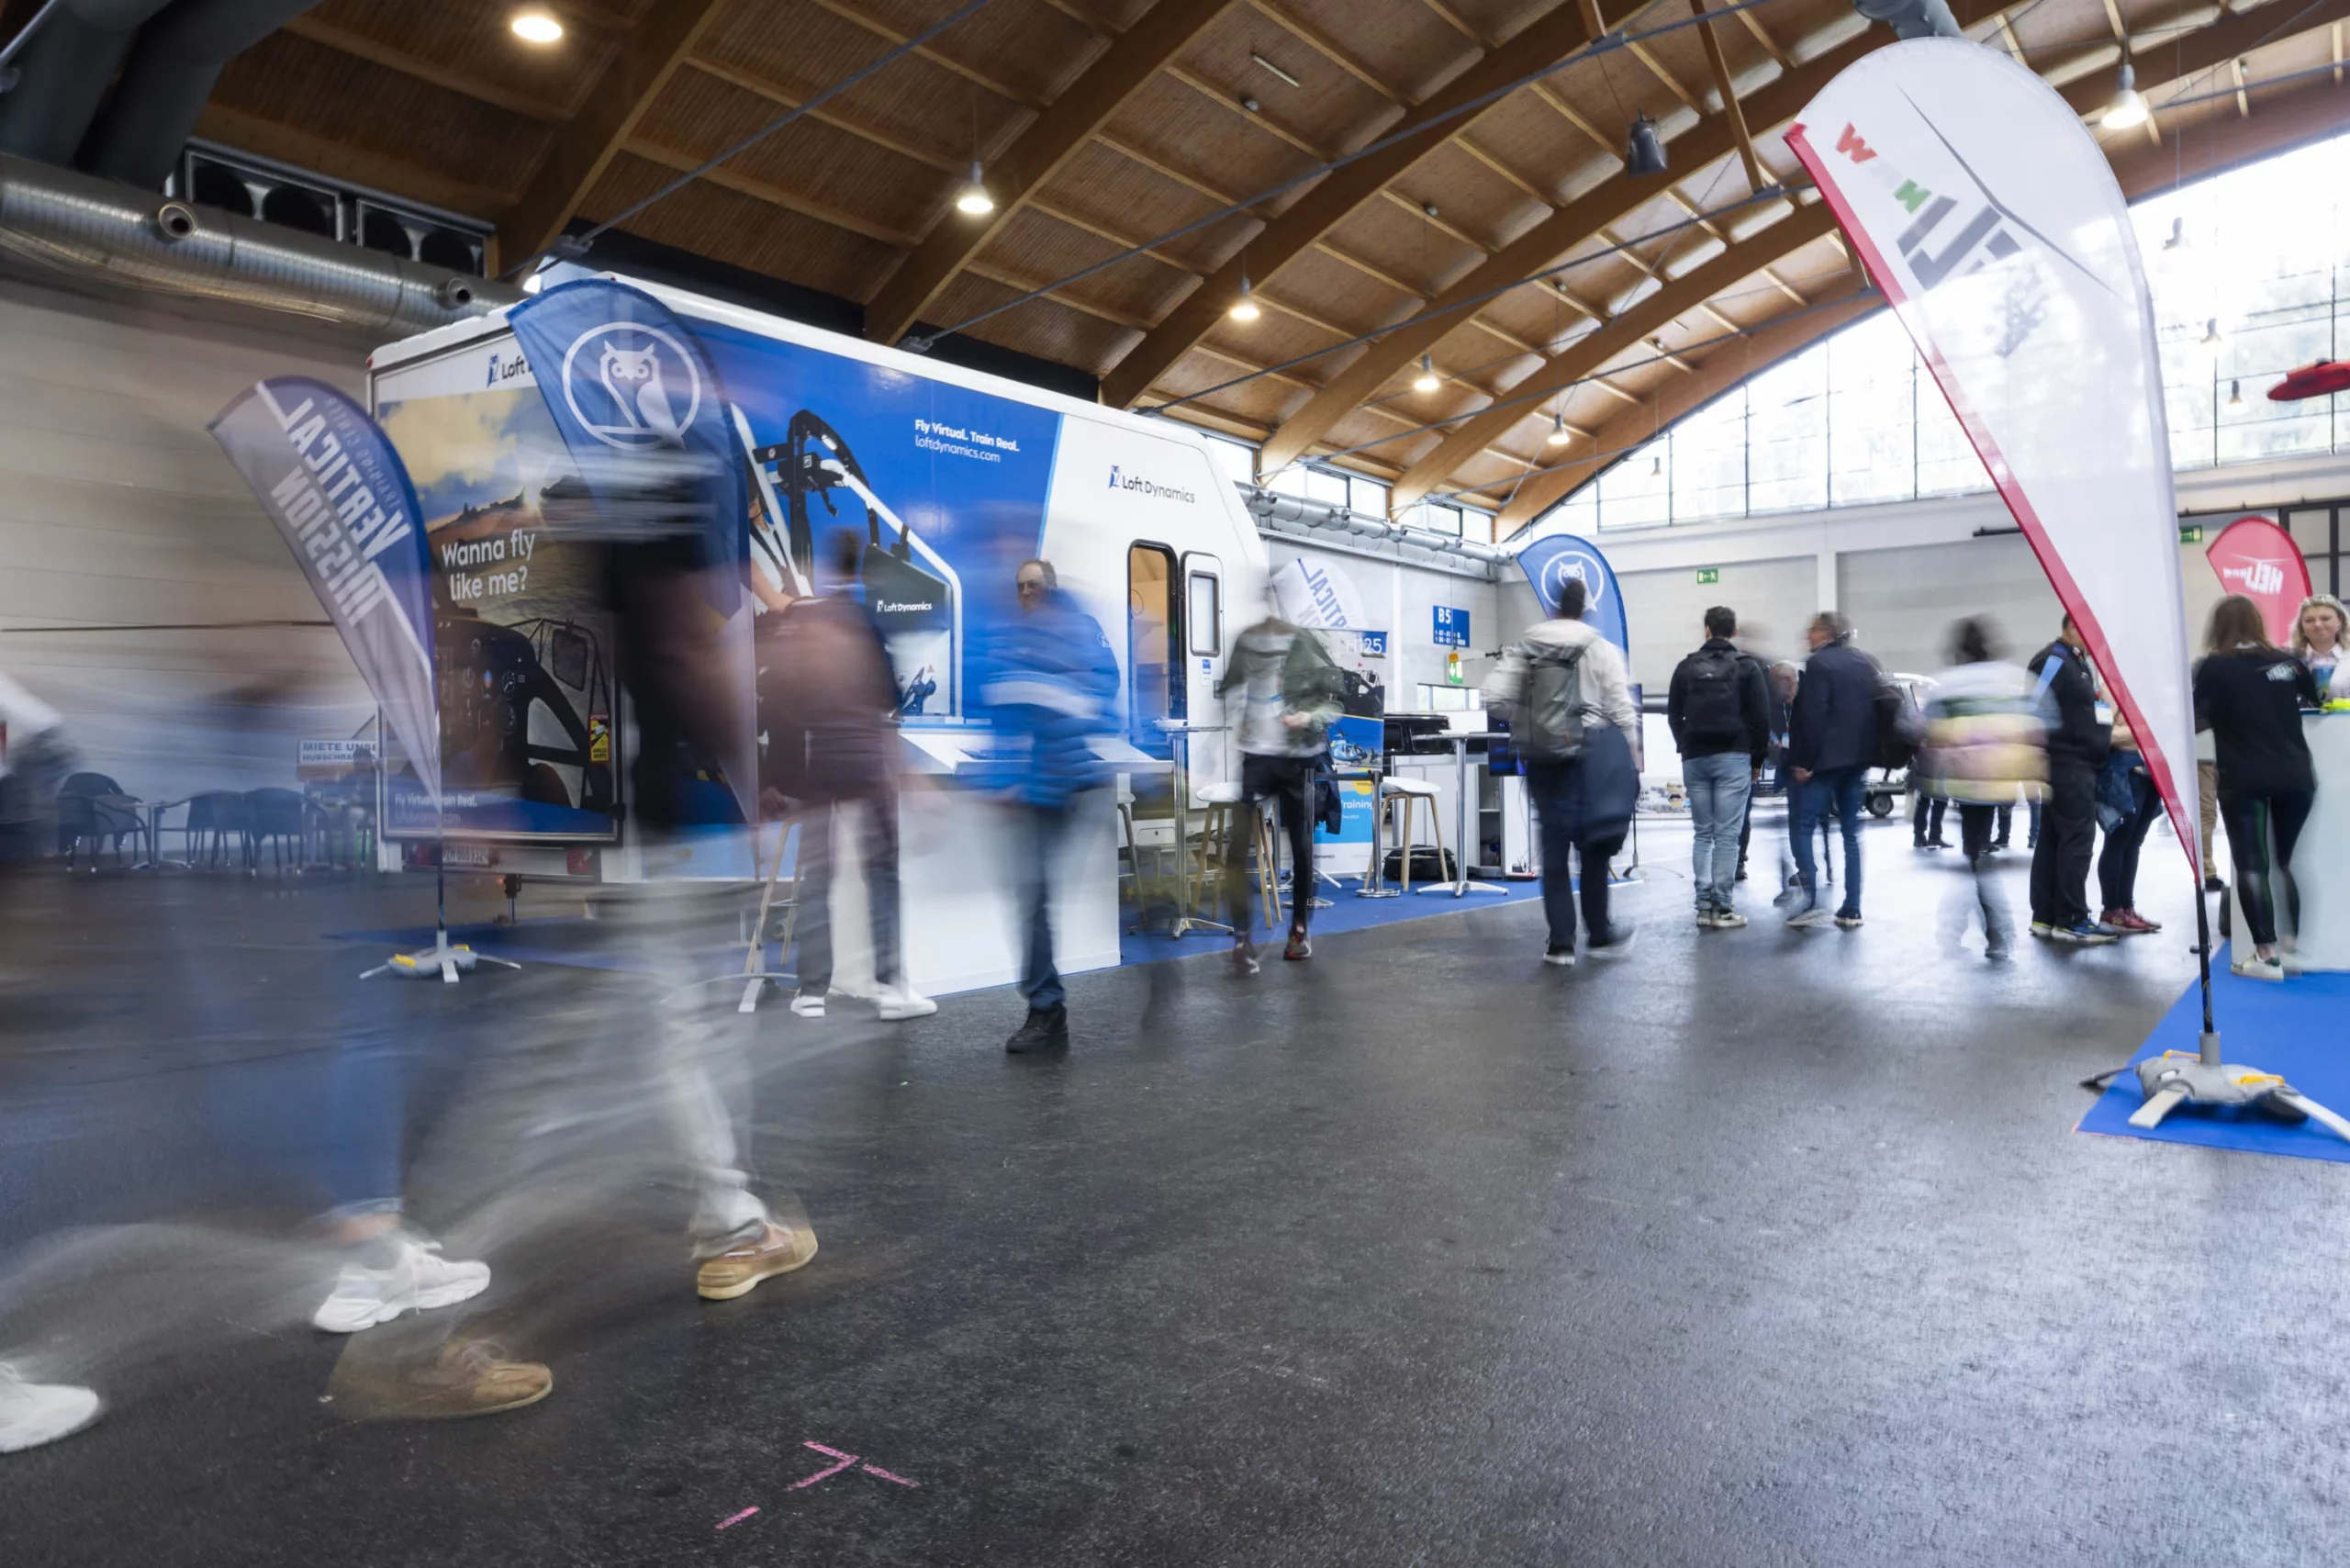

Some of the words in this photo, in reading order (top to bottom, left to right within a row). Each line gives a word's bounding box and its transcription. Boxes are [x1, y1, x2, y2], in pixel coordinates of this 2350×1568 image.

[501, 354, 526, 380] Loft
[915, 419, 930, 434] Fly
[932, 422, 968, 441] Virtual.
[969, 431, 995, 446] Train
[996, 437, 1020, 452] Real.
[915, 434, 1001, 463] loftdynamics.com
[1123, 475, 1143, 493] Loft
[1145, 480, 1195, 504] Dynamics
[442, 540, 505, 567] Wanna
[510, 528, 536, 562] fly
[450, 572, 483, 601] like
[488, 565, 528, 596] me?
[884, 602, 898, 612] Loft
[898, 600, 933, 612] Dynamics
[1438, 607, 1451, 624] B5
[303, 742, 342, 751] MIETE
